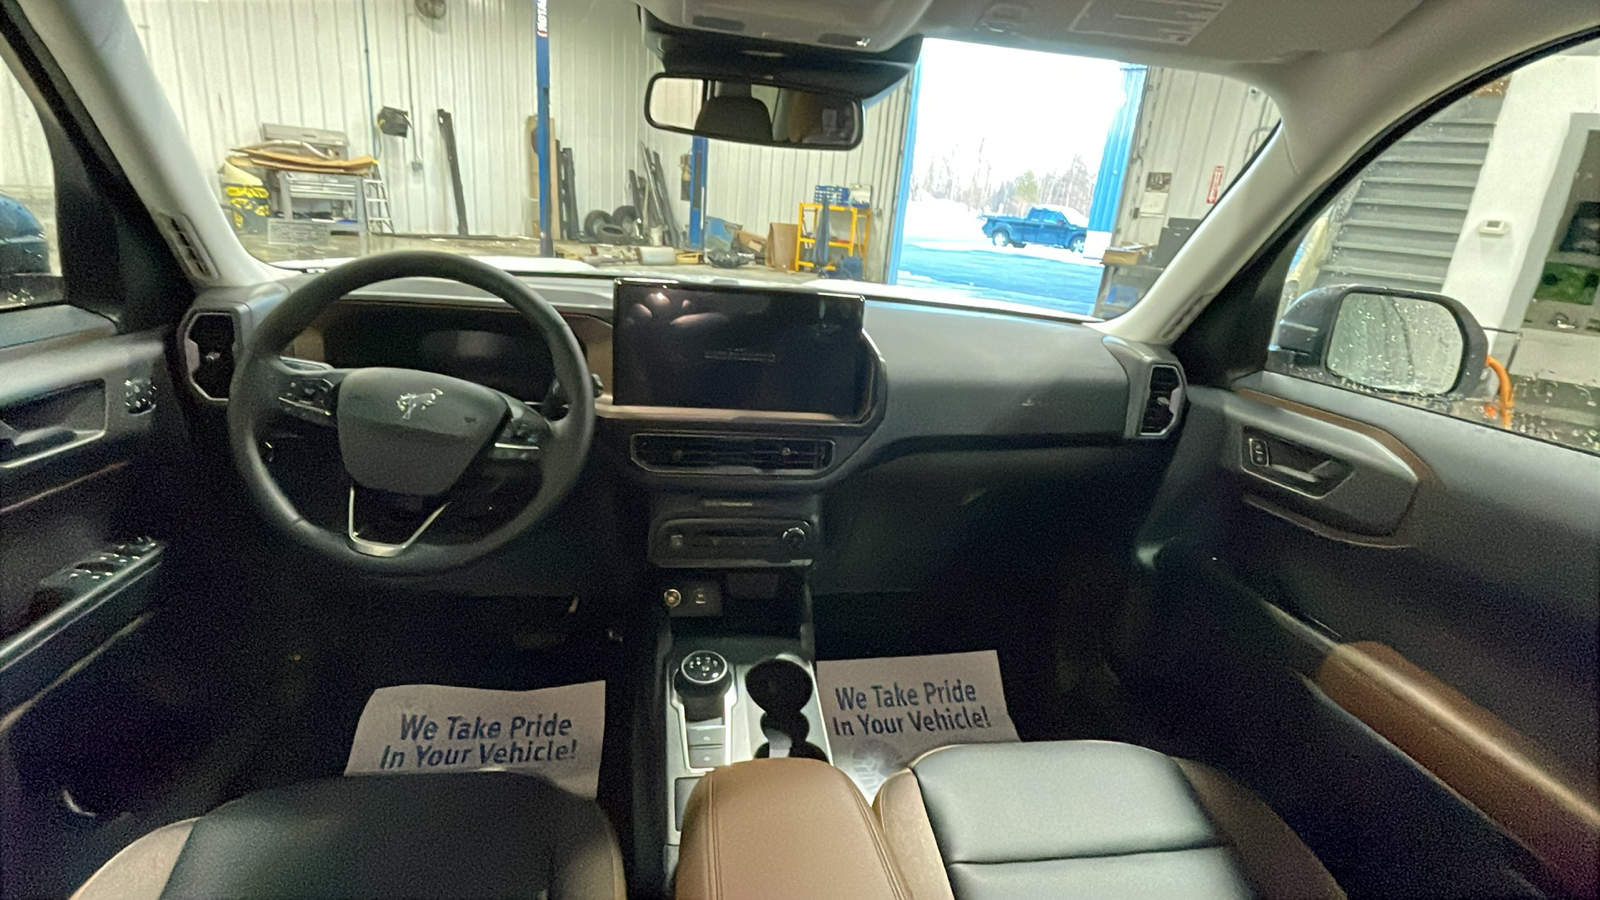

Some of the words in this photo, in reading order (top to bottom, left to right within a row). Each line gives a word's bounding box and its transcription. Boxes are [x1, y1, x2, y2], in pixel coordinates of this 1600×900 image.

[834, 687, 867, 711] We
[871, 682, 919, 707] Take
[923, 679, 976, 704] Pride
[400, 713, 438, 741] We
[447, 716, 500, 739] Take
[510, 713, 572, 737] Pride
[833, 716, 855, 736] In
[857, 712, 903, 735] Your
[907, 706, 991, 732] Vehicle!
[379, 746, 405, 769] In
[416, 746, 472, 768] Your
[479, 739, 577, 765] Vehicle!
